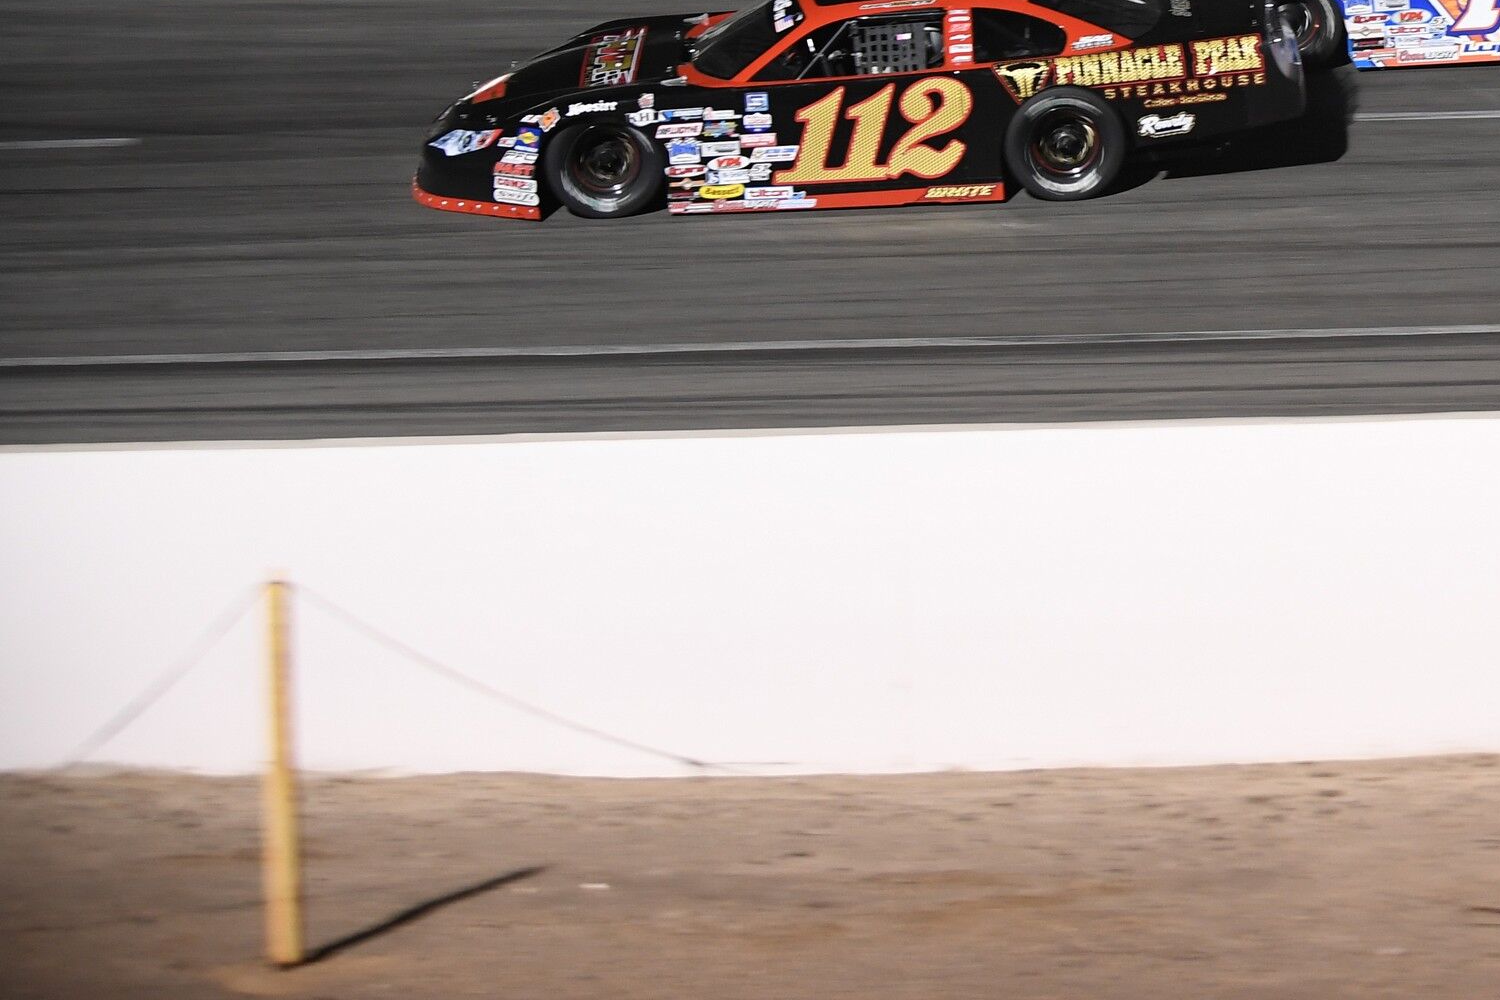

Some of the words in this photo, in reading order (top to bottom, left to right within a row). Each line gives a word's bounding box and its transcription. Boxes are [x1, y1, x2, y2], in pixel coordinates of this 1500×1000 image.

[1052, 42, 1184, 87] PINNACLE
[1193, 34, 1263, 76] PEAK
[1104, 73, 1266, 100] STEAKHOUSE
[773, 76, 974, 185] 112
